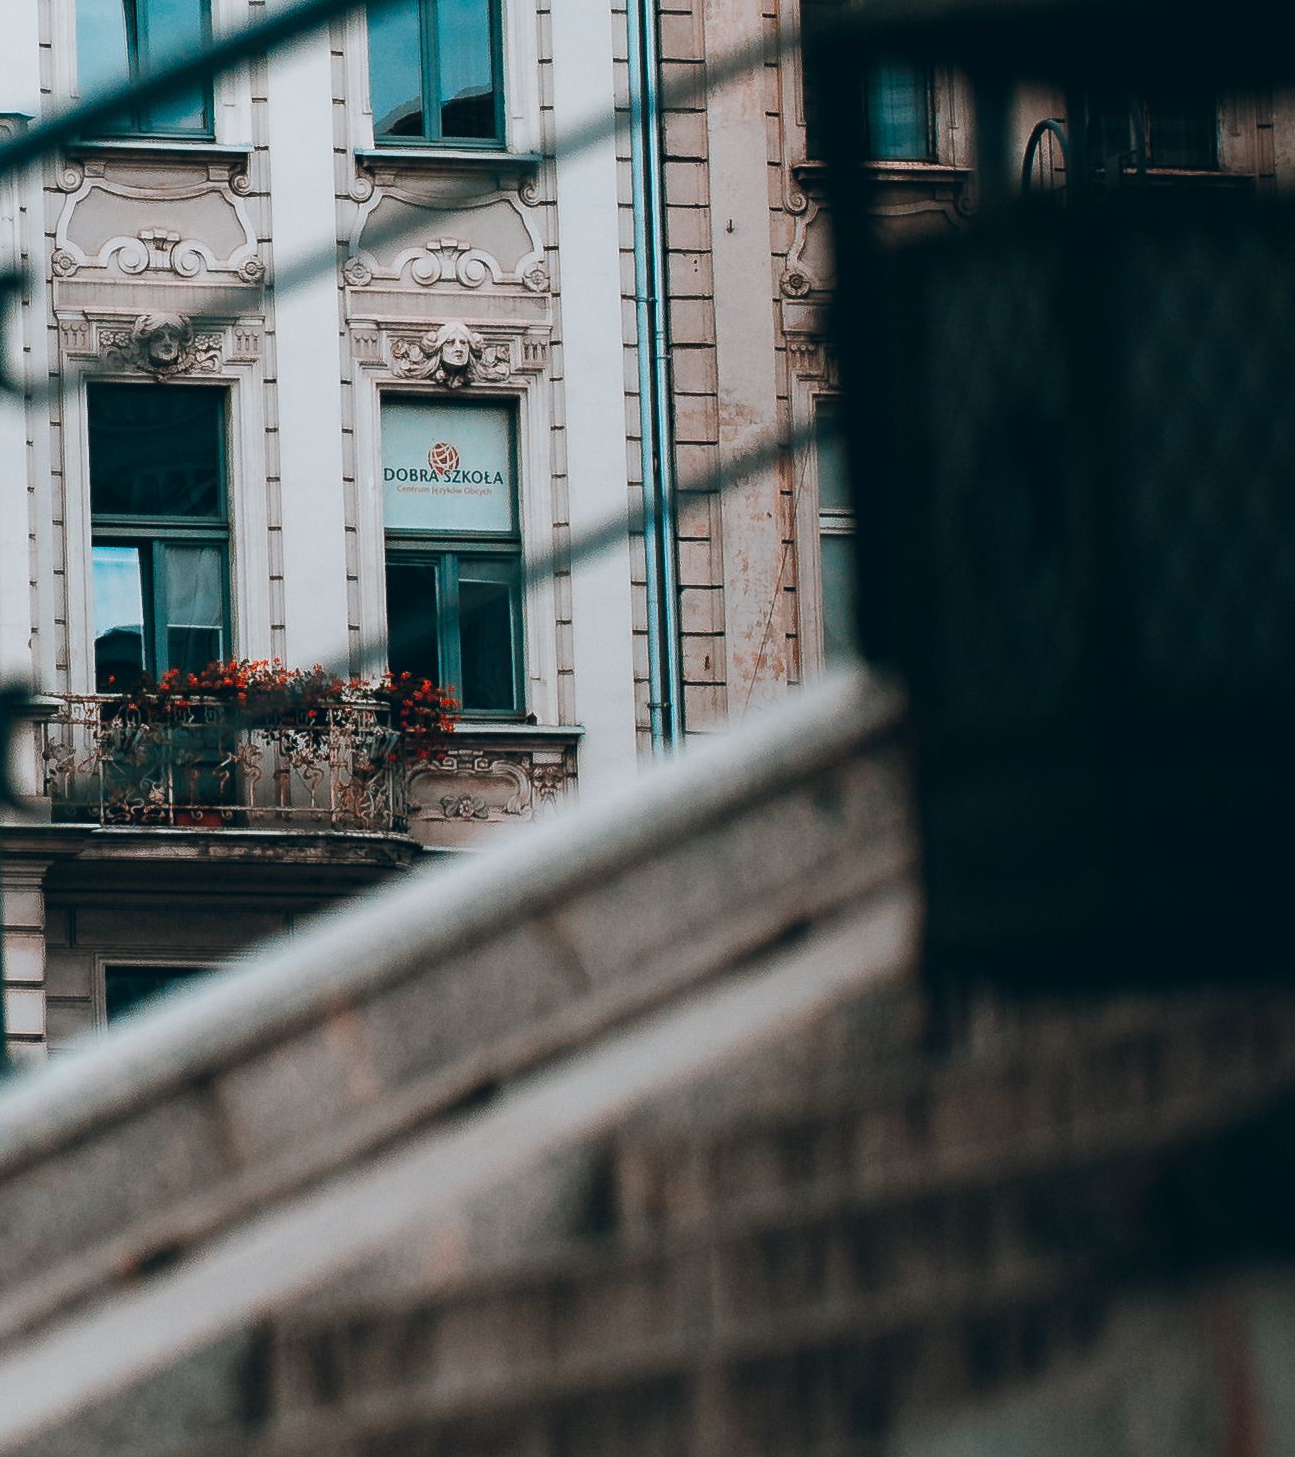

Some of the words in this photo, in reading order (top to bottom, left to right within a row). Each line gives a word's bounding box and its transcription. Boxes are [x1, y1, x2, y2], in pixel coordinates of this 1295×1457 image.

[383, 468, 439, 483] DOBRA
[443, 469, 504, 485] SZKOŁA
[396, 485, 430, 493] Centrum
